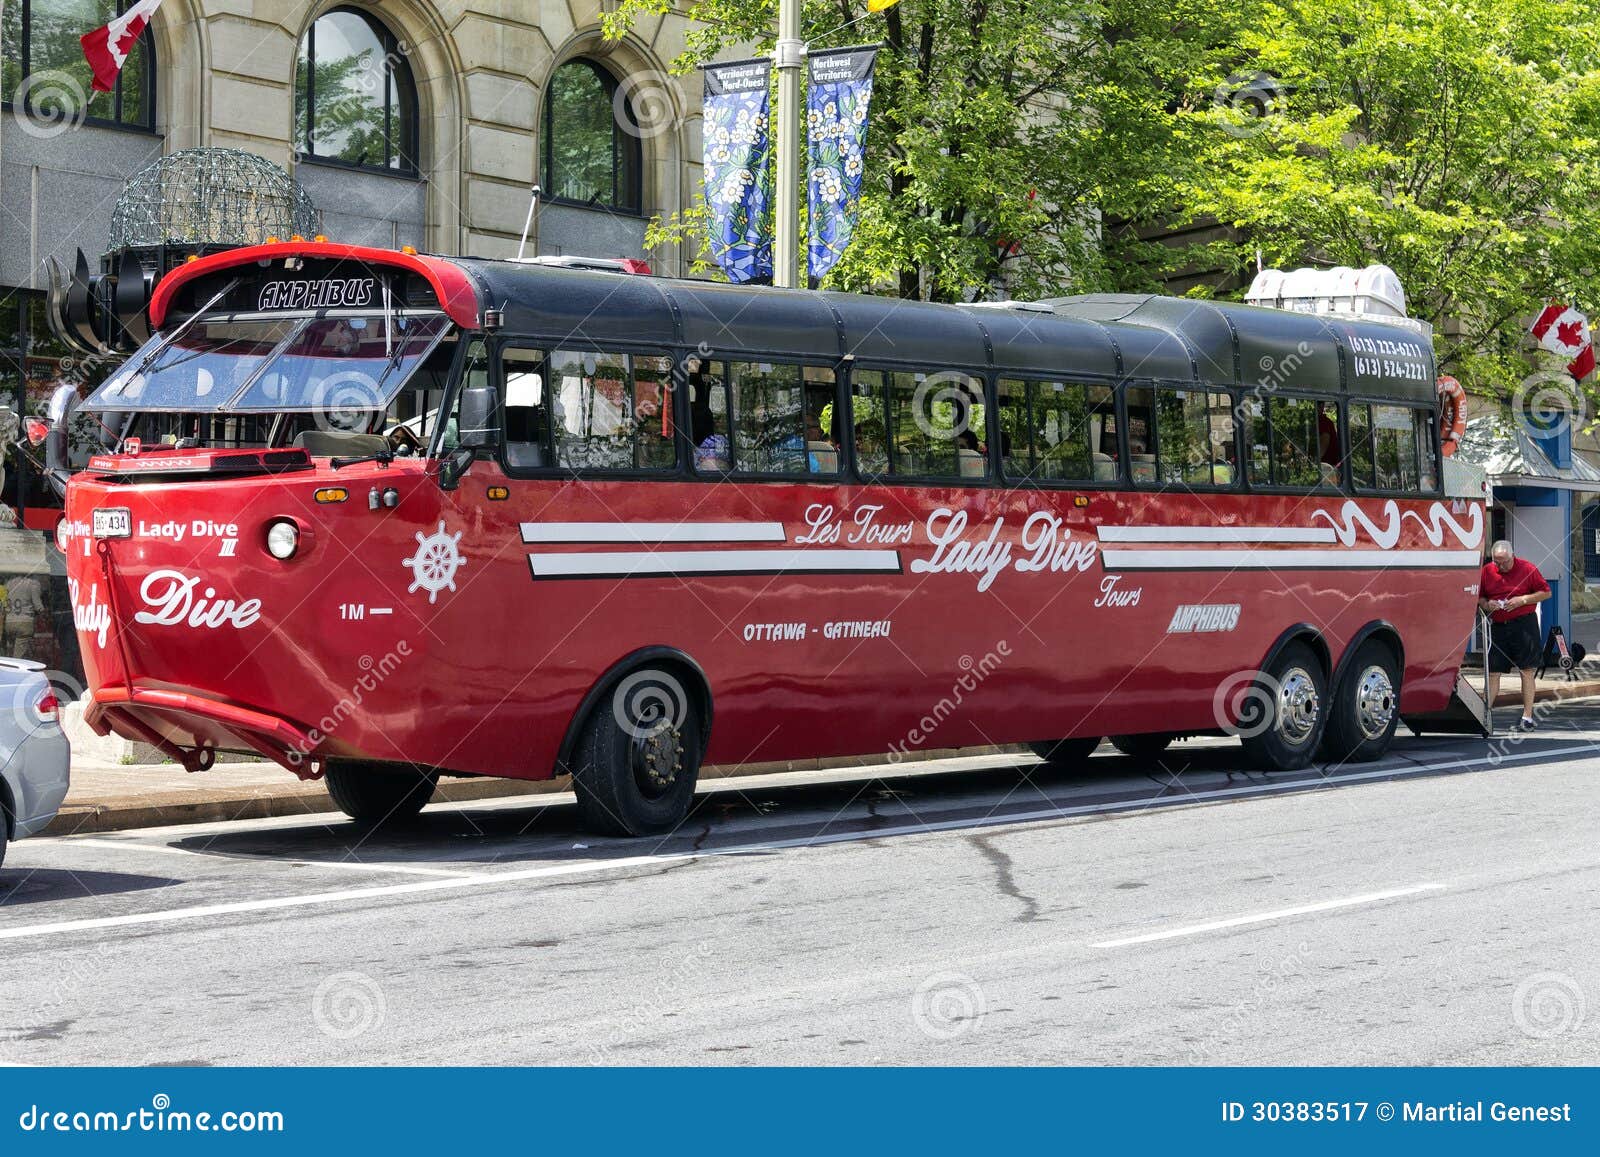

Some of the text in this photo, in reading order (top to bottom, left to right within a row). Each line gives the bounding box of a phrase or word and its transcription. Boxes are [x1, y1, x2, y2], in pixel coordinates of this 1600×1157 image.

[716, 65, 765, 80] Territoires du
[813, 56, 851, 69] Northwest
[722, 78, 765, 92] Nord-Ouest
[813, 70, 852, 80] Territories
[258, 278, 374, 311] AMPHIBUS
[1348, 336, 1422, 358] (613) 223-6211
[1354, 355, 1427, 380] (613) 524-2221
[74, 520, 91, 537] Dive
[139, 520, 239, 542] Lady Dive
[795, 503, 914, 543] Les Tours
[218, 538, 239, 557] III
[910, 507, 1097, 593] Lady Dive
[134, 569, 262, 629] Dive
[1094, 575, 1142, 608] Tours
[338, 603, 364, 620] 1M
[1166, 603, 1241, 634] AMPHIBUS
[743, 623, 807, 642] OTTAWA
[823, 620, 892, 640] GATINEAU
